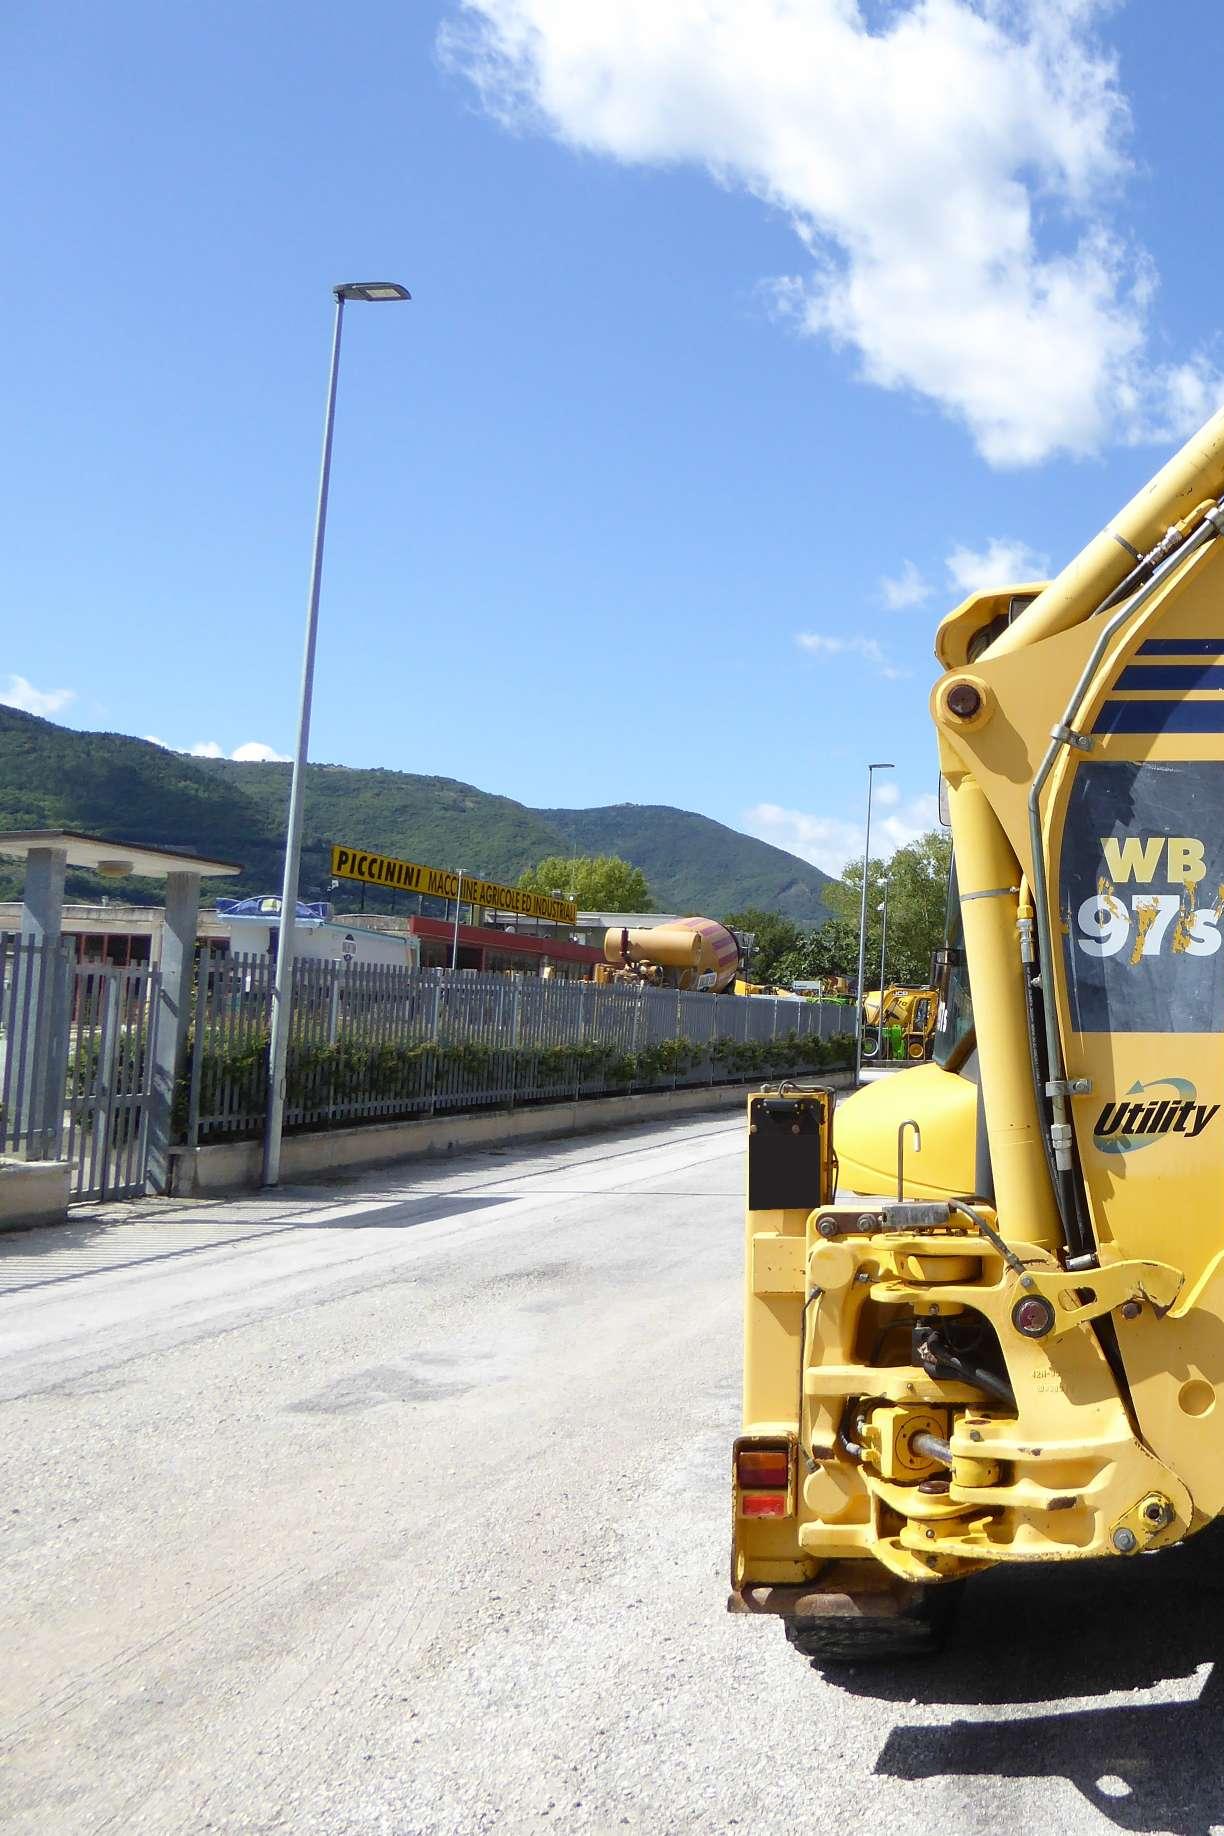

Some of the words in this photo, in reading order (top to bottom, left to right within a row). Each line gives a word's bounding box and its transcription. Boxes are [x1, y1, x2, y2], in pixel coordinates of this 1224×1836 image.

[336, 850, 421, 888] PICCININI
[479, 886, 520, 911] AGRICOLE
[521, 893, 532, 913] ED
[1100, 837, 1207, 883] WB
[1093, 1100, 1221, 1138] Utility
